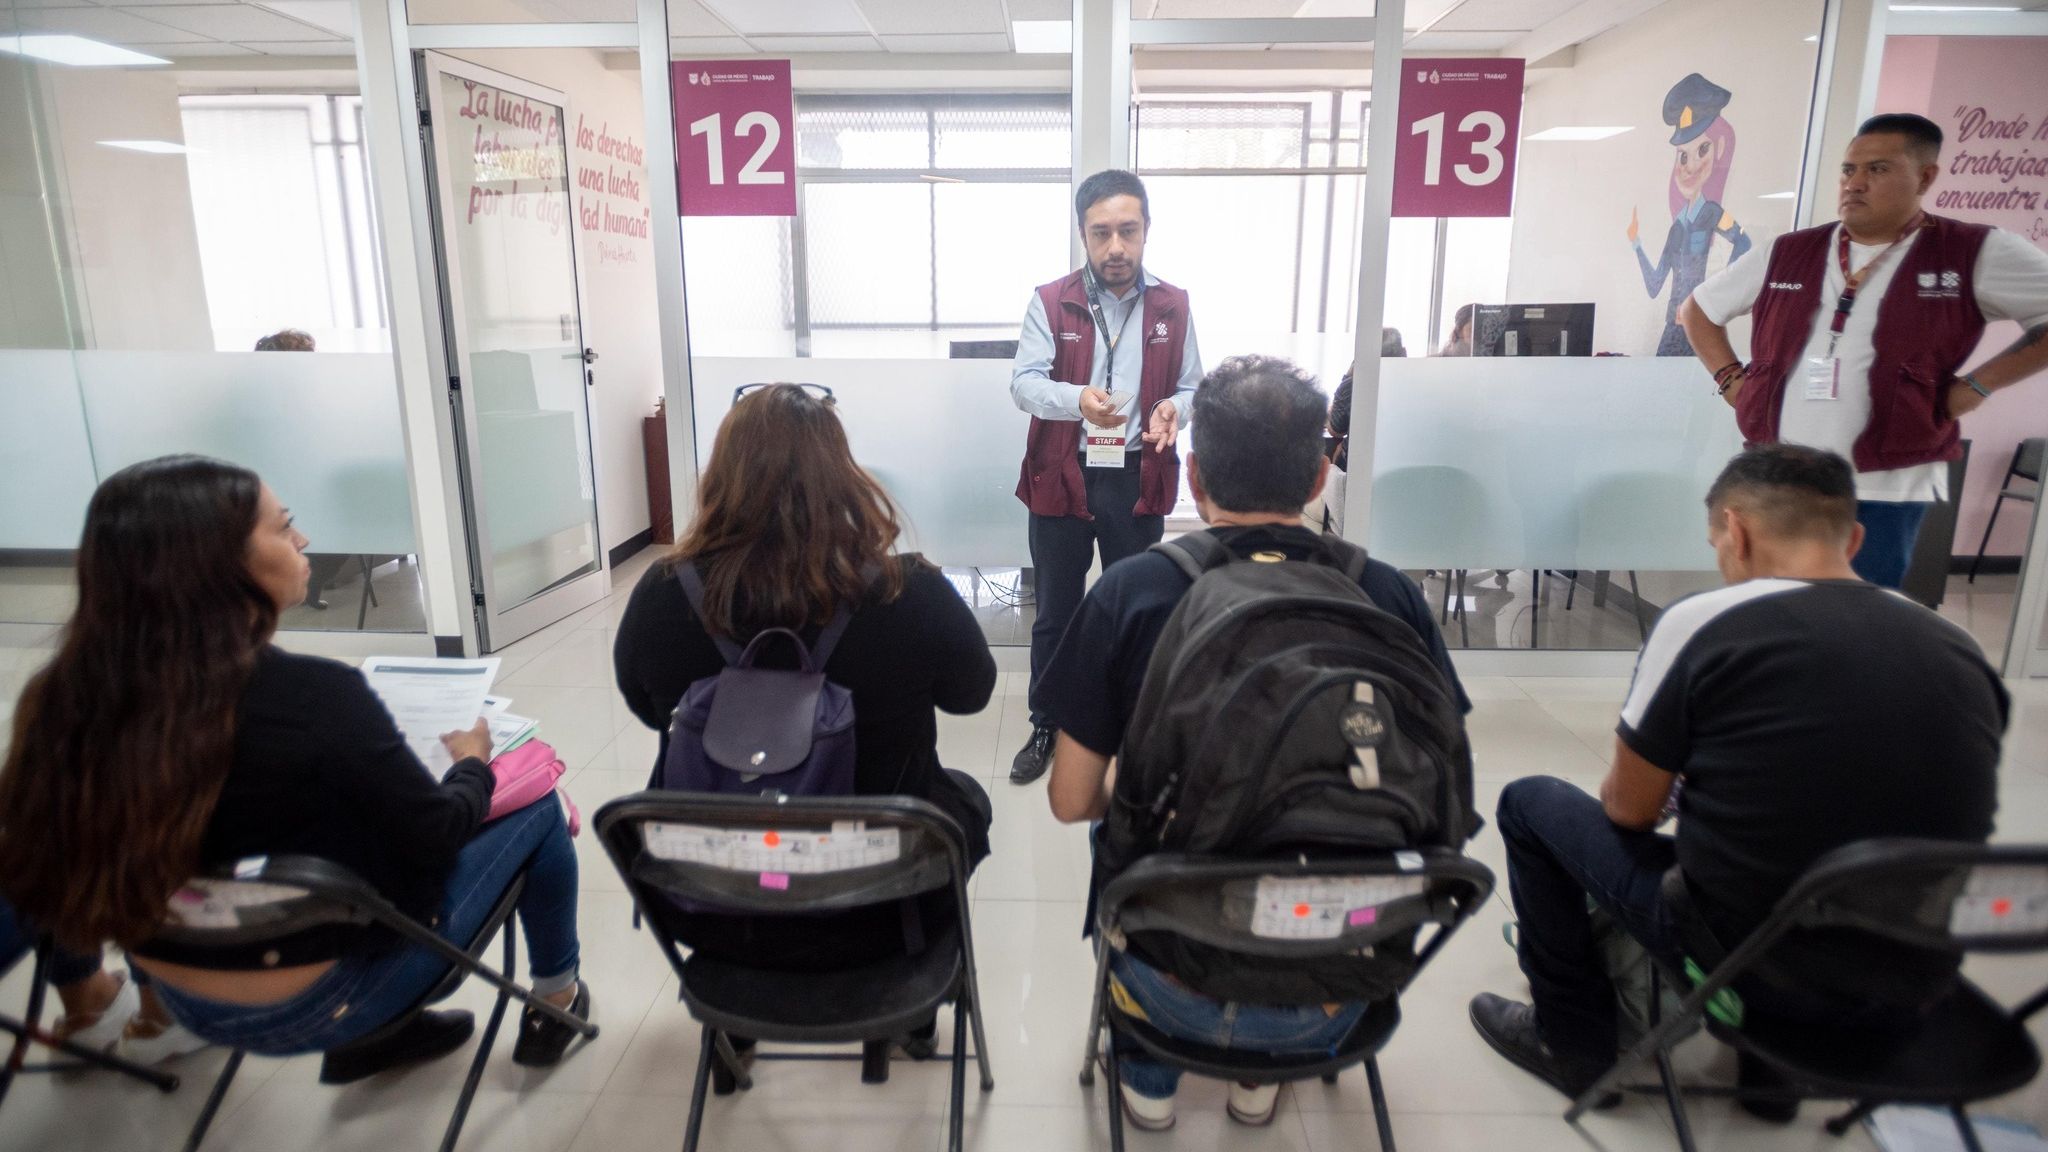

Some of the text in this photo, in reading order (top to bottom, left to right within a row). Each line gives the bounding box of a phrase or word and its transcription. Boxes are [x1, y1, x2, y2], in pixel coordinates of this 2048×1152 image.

[494, 90, 542, 134] lucha
[576, 113, 594, 150] los
[597, 122, 644, 166] derechos
[690, 111, 785, 185] 12
[1411, 110, 1506, 187] 13
[578, 167, 604, 193] una
[607, 165, 640, 202] lucha
[1935, 186, 2041, 210] encuentra
[467, 186, 503, 225] por
[1095, 437, 1118, 445] STAFF
